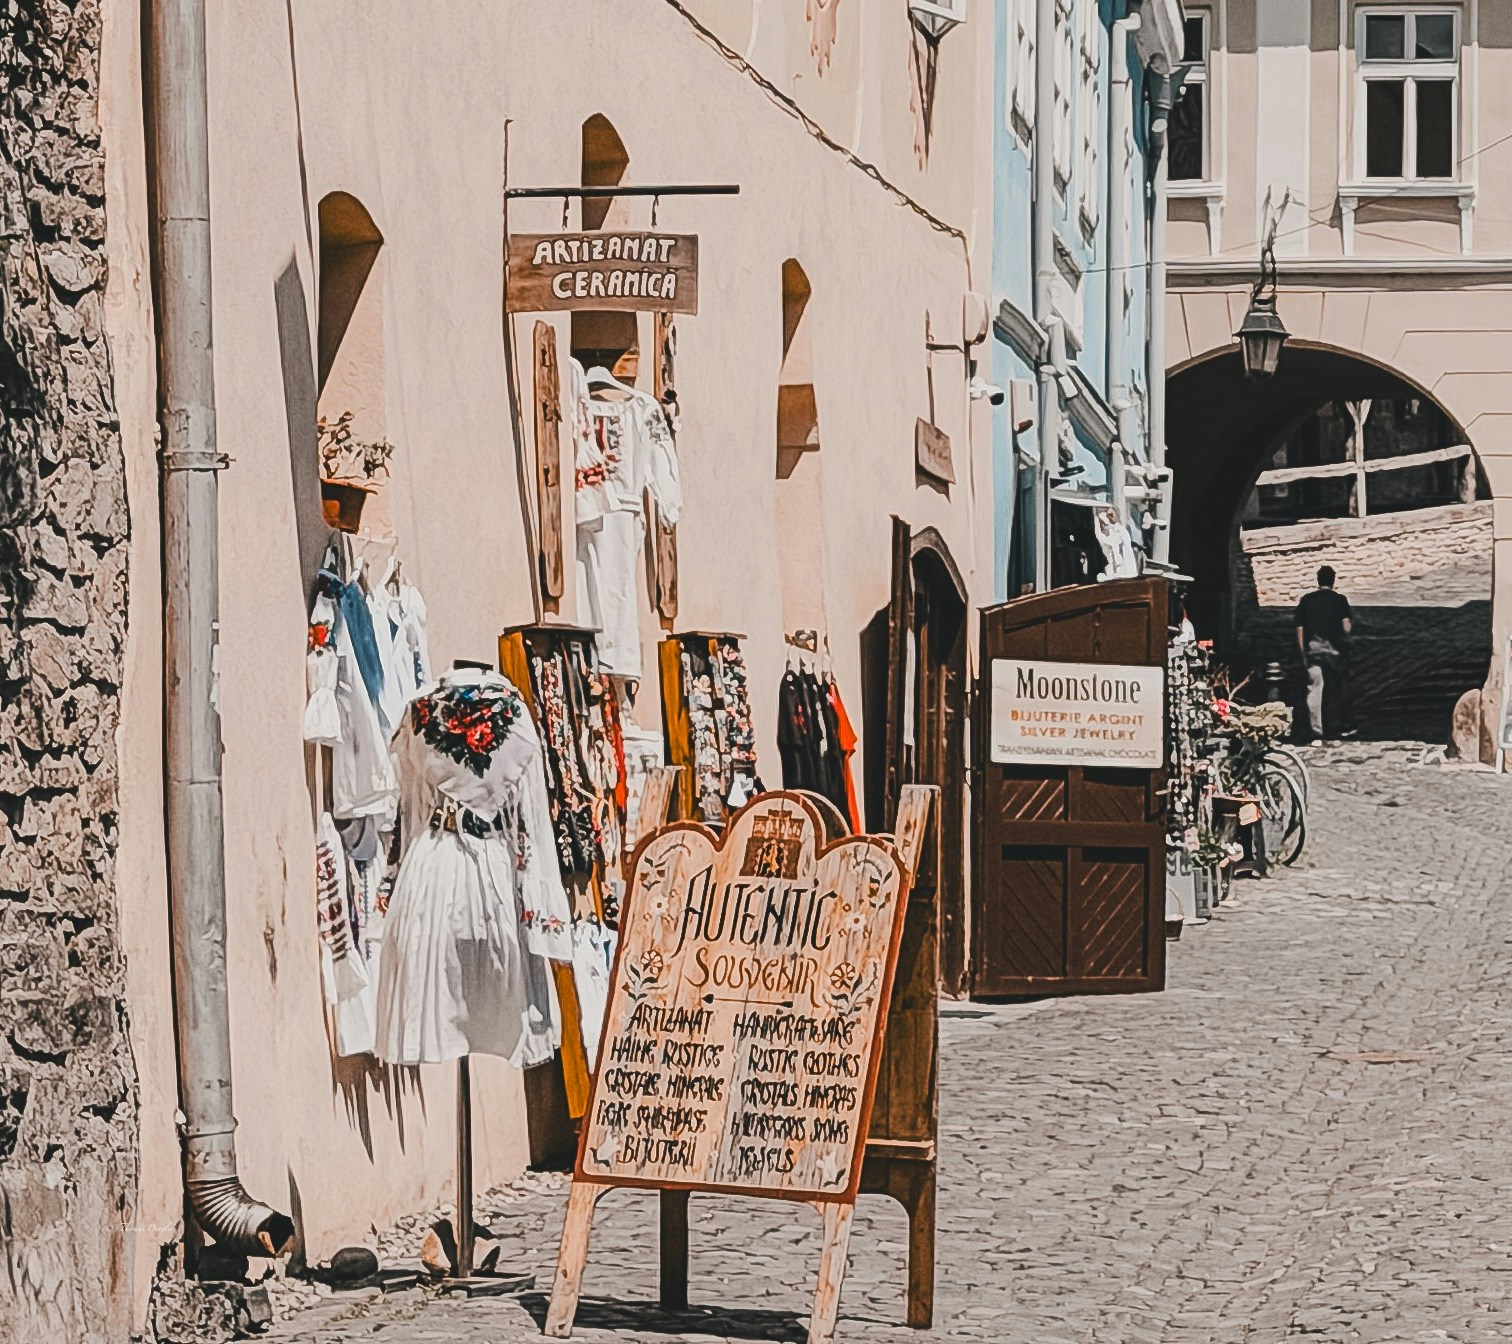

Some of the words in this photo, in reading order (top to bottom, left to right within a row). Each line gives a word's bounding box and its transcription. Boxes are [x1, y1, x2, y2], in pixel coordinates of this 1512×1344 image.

[532, 236, 676, 265] ARTIZANAT
[1016, 666, 1142, 704] Moonstone
[1020, 725, 1066, 737] SILVER
[1072, 728, 1136, 741] JEWELRY
[669, 864, 838, 959] AUTENTIC
[684, 946, 821, 1008] SOUVENIR
[625, 1001, 714, 1037] ARTIZANAT
[610, 1032, 658, 1065] HAINE
[661, 1035, 725, 1070] RUSTICE
[748, 1043, 798, 1075] RUSTIC
